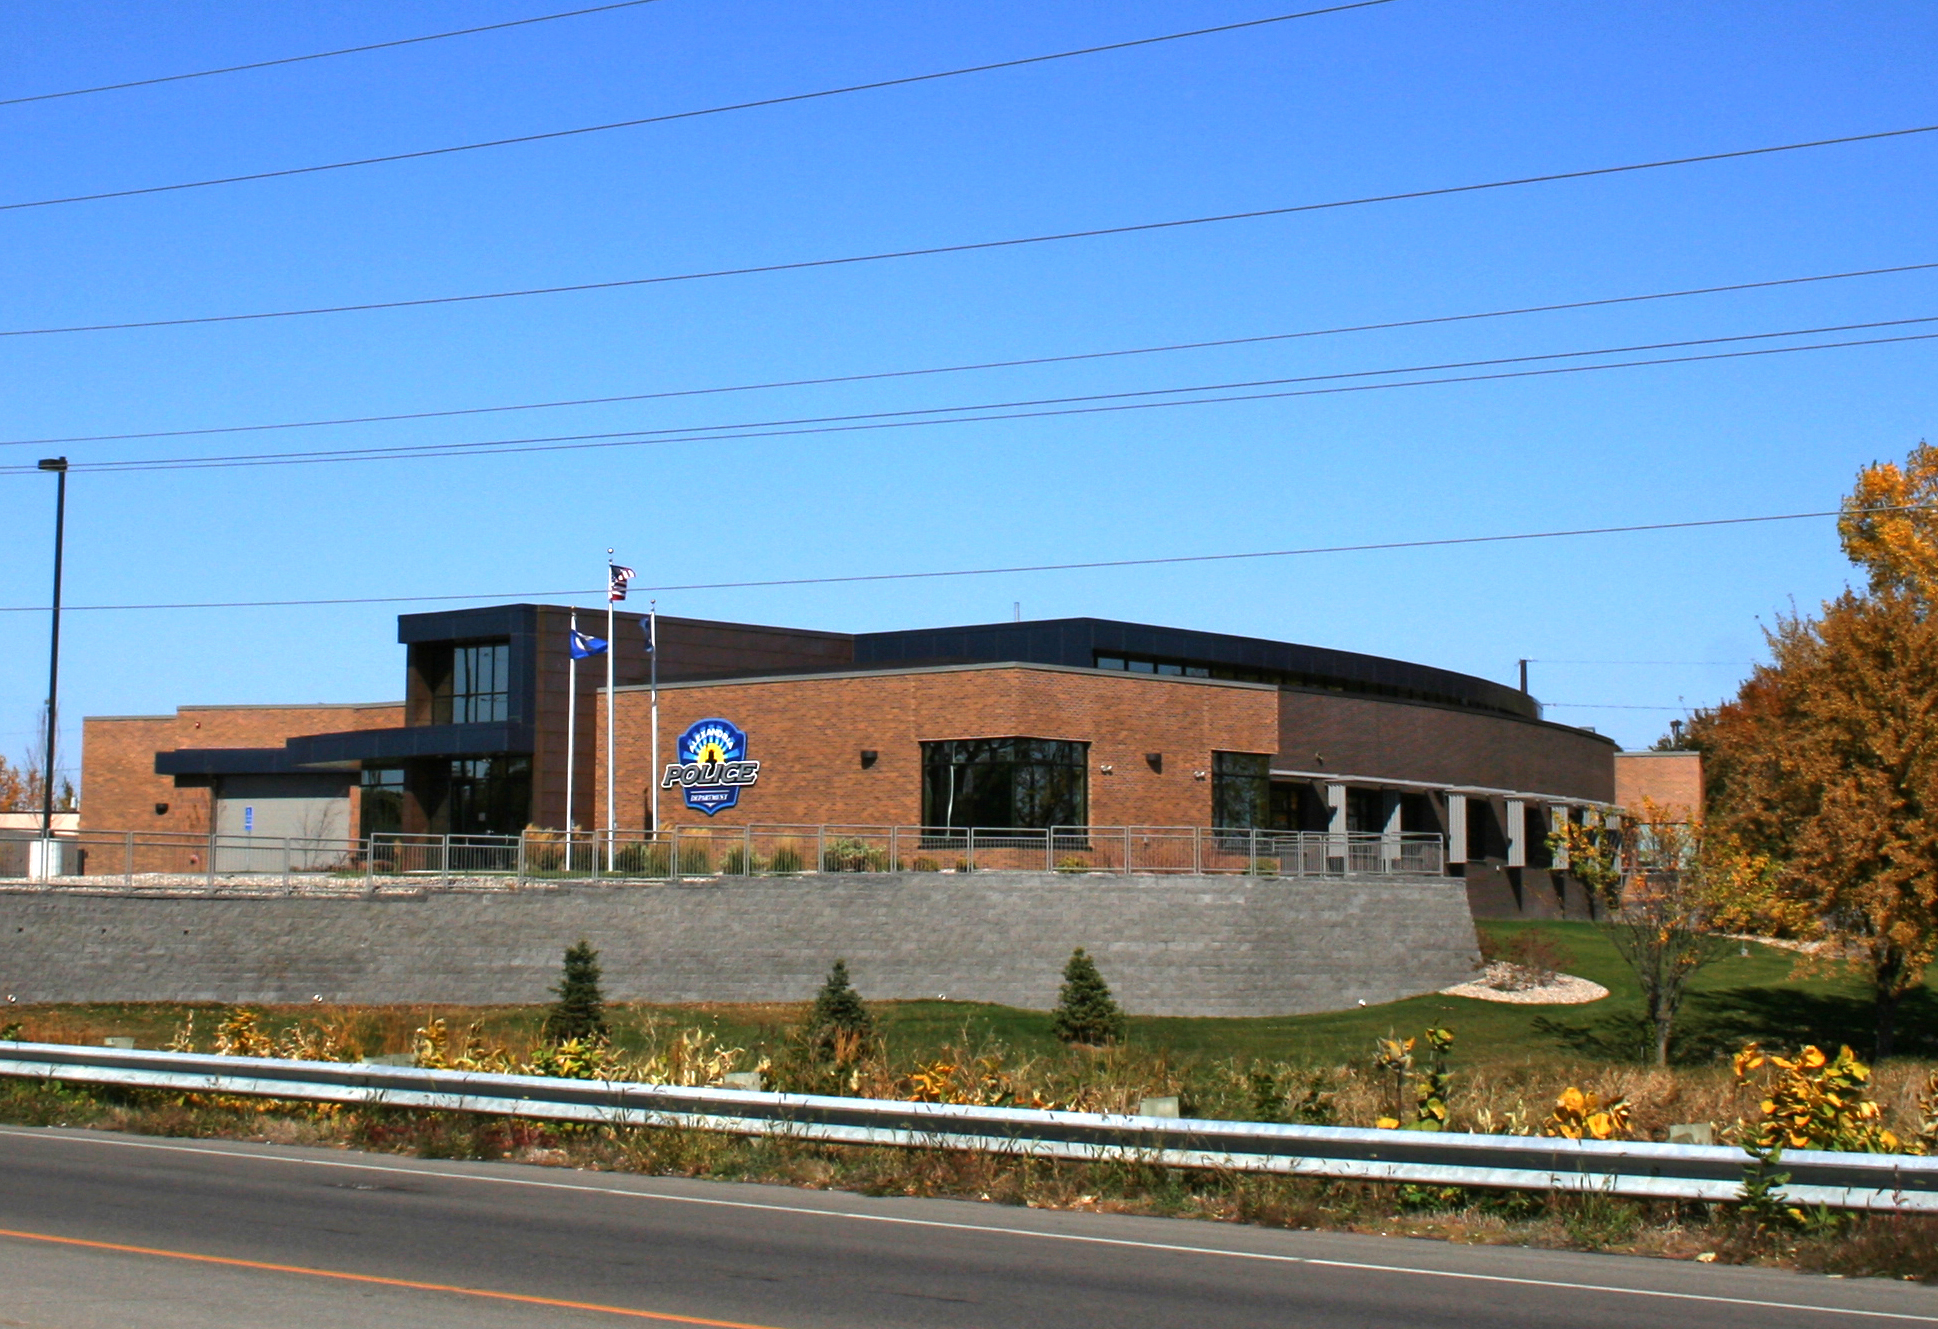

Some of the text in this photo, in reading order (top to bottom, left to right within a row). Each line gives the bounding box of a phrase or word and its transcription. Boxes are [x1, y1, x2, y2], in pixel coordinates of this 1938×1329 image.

[689, 728, 734, 753] ALEXANDRIA
[662, 762, 759, 787] POLICE
[690, 794, 728, 802] DEPARTMENT
